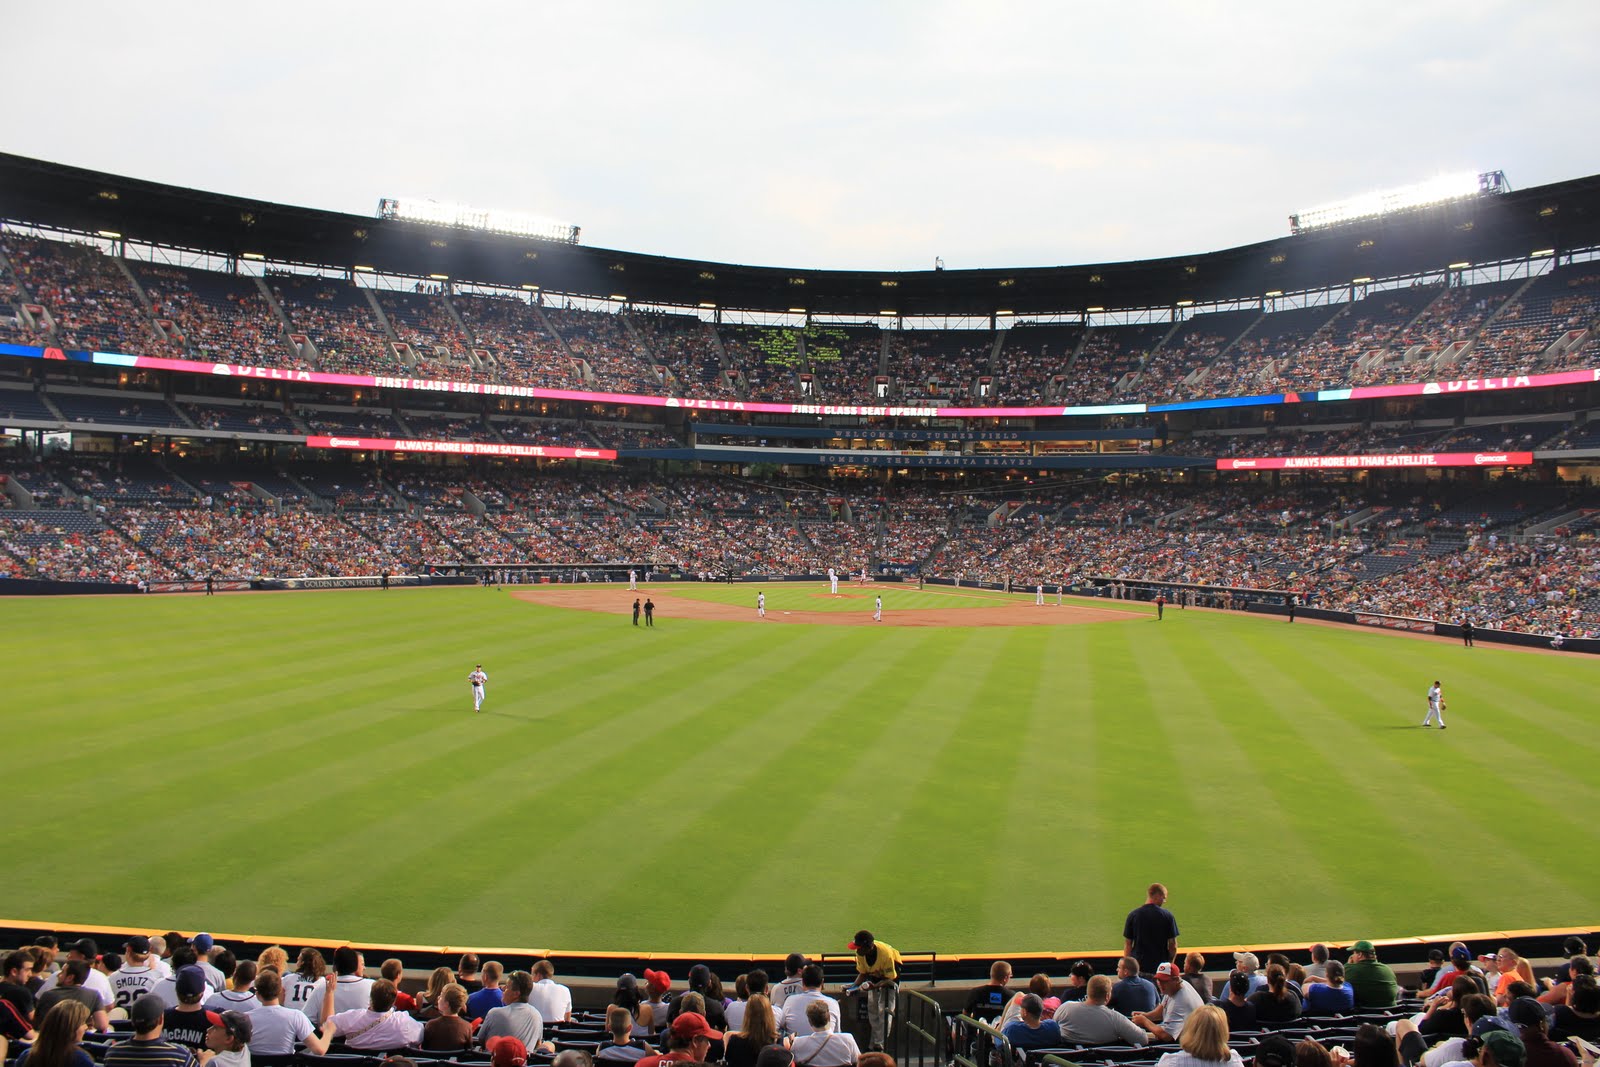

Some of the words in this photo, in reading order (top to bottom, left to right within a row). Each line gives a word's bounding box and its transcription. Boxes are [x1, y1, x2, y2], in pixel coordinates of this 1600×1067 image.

[375, 377, 409, 389] FIRST
[412, 379, 449, 392] CLASS
[452, 382, 481, 394] SEAT
[484, 385, 534, 397] UPGRADE
[791, 404, 822, 414] FIRST
[823, 405, 857, 415] CLASS
[860, 406, 887, 416] SEAT
[889, 407, 938, 417] UPGRADE
[835, 430, 894, 438] WELCOME
[394, 440, 434, 452] ALWAYS
[434, 442, 460, 453] MORE
[462, 443, 475, 453] HD
[475, 444, 500, 454] THAN
[500, 445, 545, 456] SATELLITE.
[1284, 457, 1320, 468] ALWAYS
[1320, 457, 1345, 467] MORE
[1346, 456, 1359, 466] HD
[1360, 456, 1385, 466] THAN
[1386, 455, 1437, 465] SATELLITE.
[304, 580, 332, 588] GOLDEN
[333, 580, 355, 588] MOON
[116, 976, 149, 989] SMOLTZ
[783, 985, 796, 995] COX
[160, 1028, 203, 1044] McCANN
